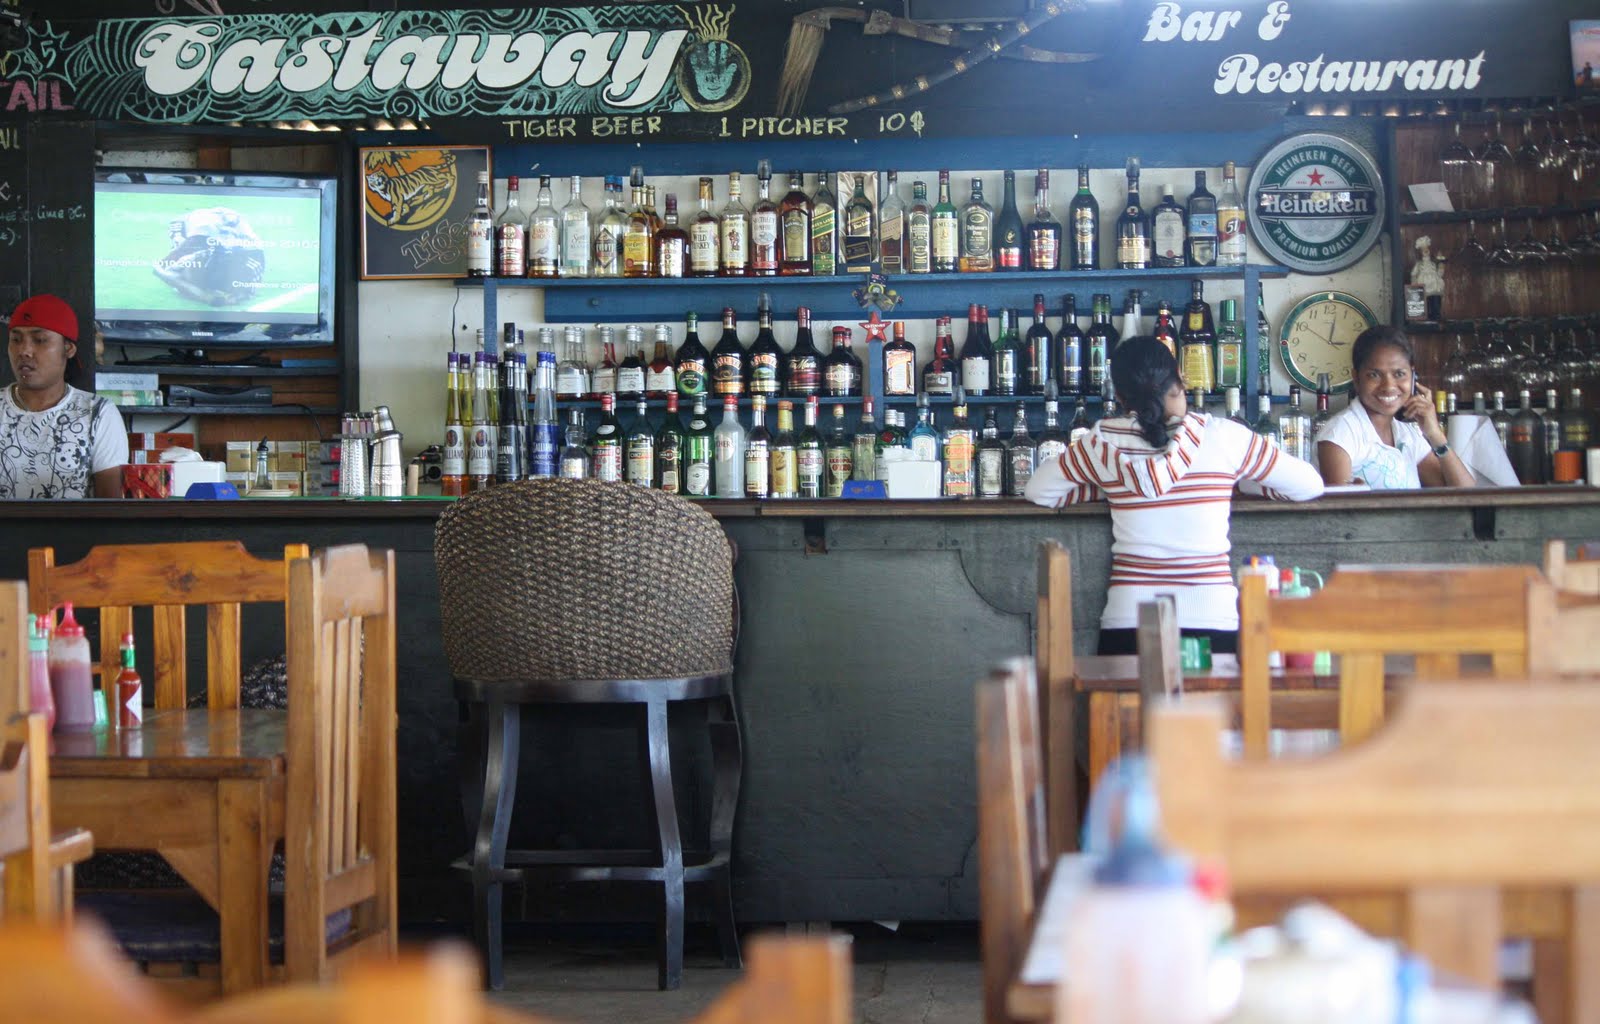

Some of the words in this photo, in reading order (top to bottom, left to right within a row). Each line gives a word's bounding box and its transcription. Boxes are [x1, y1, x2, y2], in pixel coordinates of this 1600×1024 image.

[1142, 1, 1242, 42] Bar
[1258, 0, 1291, 41] &
[135, 18, 688, 106] Castaway
[1213, 50, 1487, 95] Restaurant
[0, 79, 75, 112] AIL
[502, 118, 577, 138] TIGER
[591, 116, 662, 137] BEER
[719, 117, 729, 137] 1
[742, 117, 849, 138] PITCHER
[1275, 150, 1327, 177] HEINEKEN
[1331, 155, 1357, 177] BEER
[1265, 193, 1369, 214] Heineken
[1226, 220, 1239, 234] 51
[401, 217, 470, 270] Tige
[1273, 227, 1318, 257] PREMIUM
[1322, 226, 1360, 255] QUALITY
[1309, 310, 1318, 319] 11
[1323, 304, 1337, 315] 12
[1295, 322, 1309, 332] 10
[1352, 321, 1363, 332] 2
[1291, 337, 1300, 347] 9
[1296, 353, 1307, 362] 8
[1310, 366, 1318, 376] 7
[1341, 367, 1350, 377] 5
